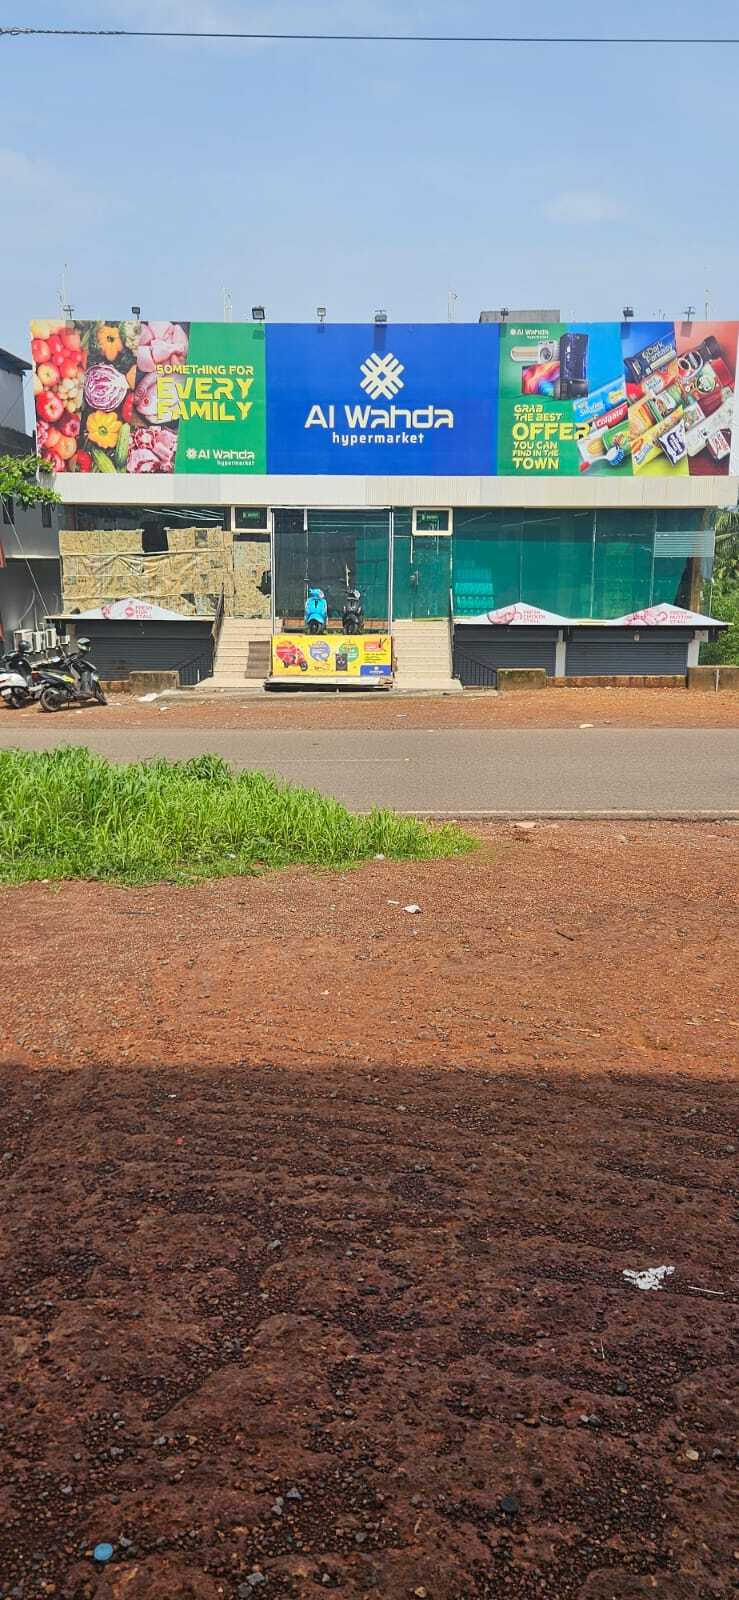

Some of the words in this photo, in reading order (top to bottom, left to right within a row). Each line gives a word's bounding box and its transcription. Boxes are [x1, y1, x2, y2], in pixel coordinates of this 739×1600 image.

[157, 365, 225, 374] SOMETHING
[230, 365, 253, 375] FOR
[156, 377, 253, 400] EVERY
[157, 401, 253, 420] FAMILY
[514, 404, 543, 413] GRAB
[344, 405, 453, 428] Wahda
[536, 413, 561, 421] BEST
[596, 409, 623, 427] Colgate
[512, 423, 590, 440] OFFER
[332, 432, 424, 446] hypermarket
[514, 441, 534, 449] YOU
[536, 441, 557, 450] CAN
[212, 449, 255, 460] Wahda
[513, 458, 559, 469] TOWN
